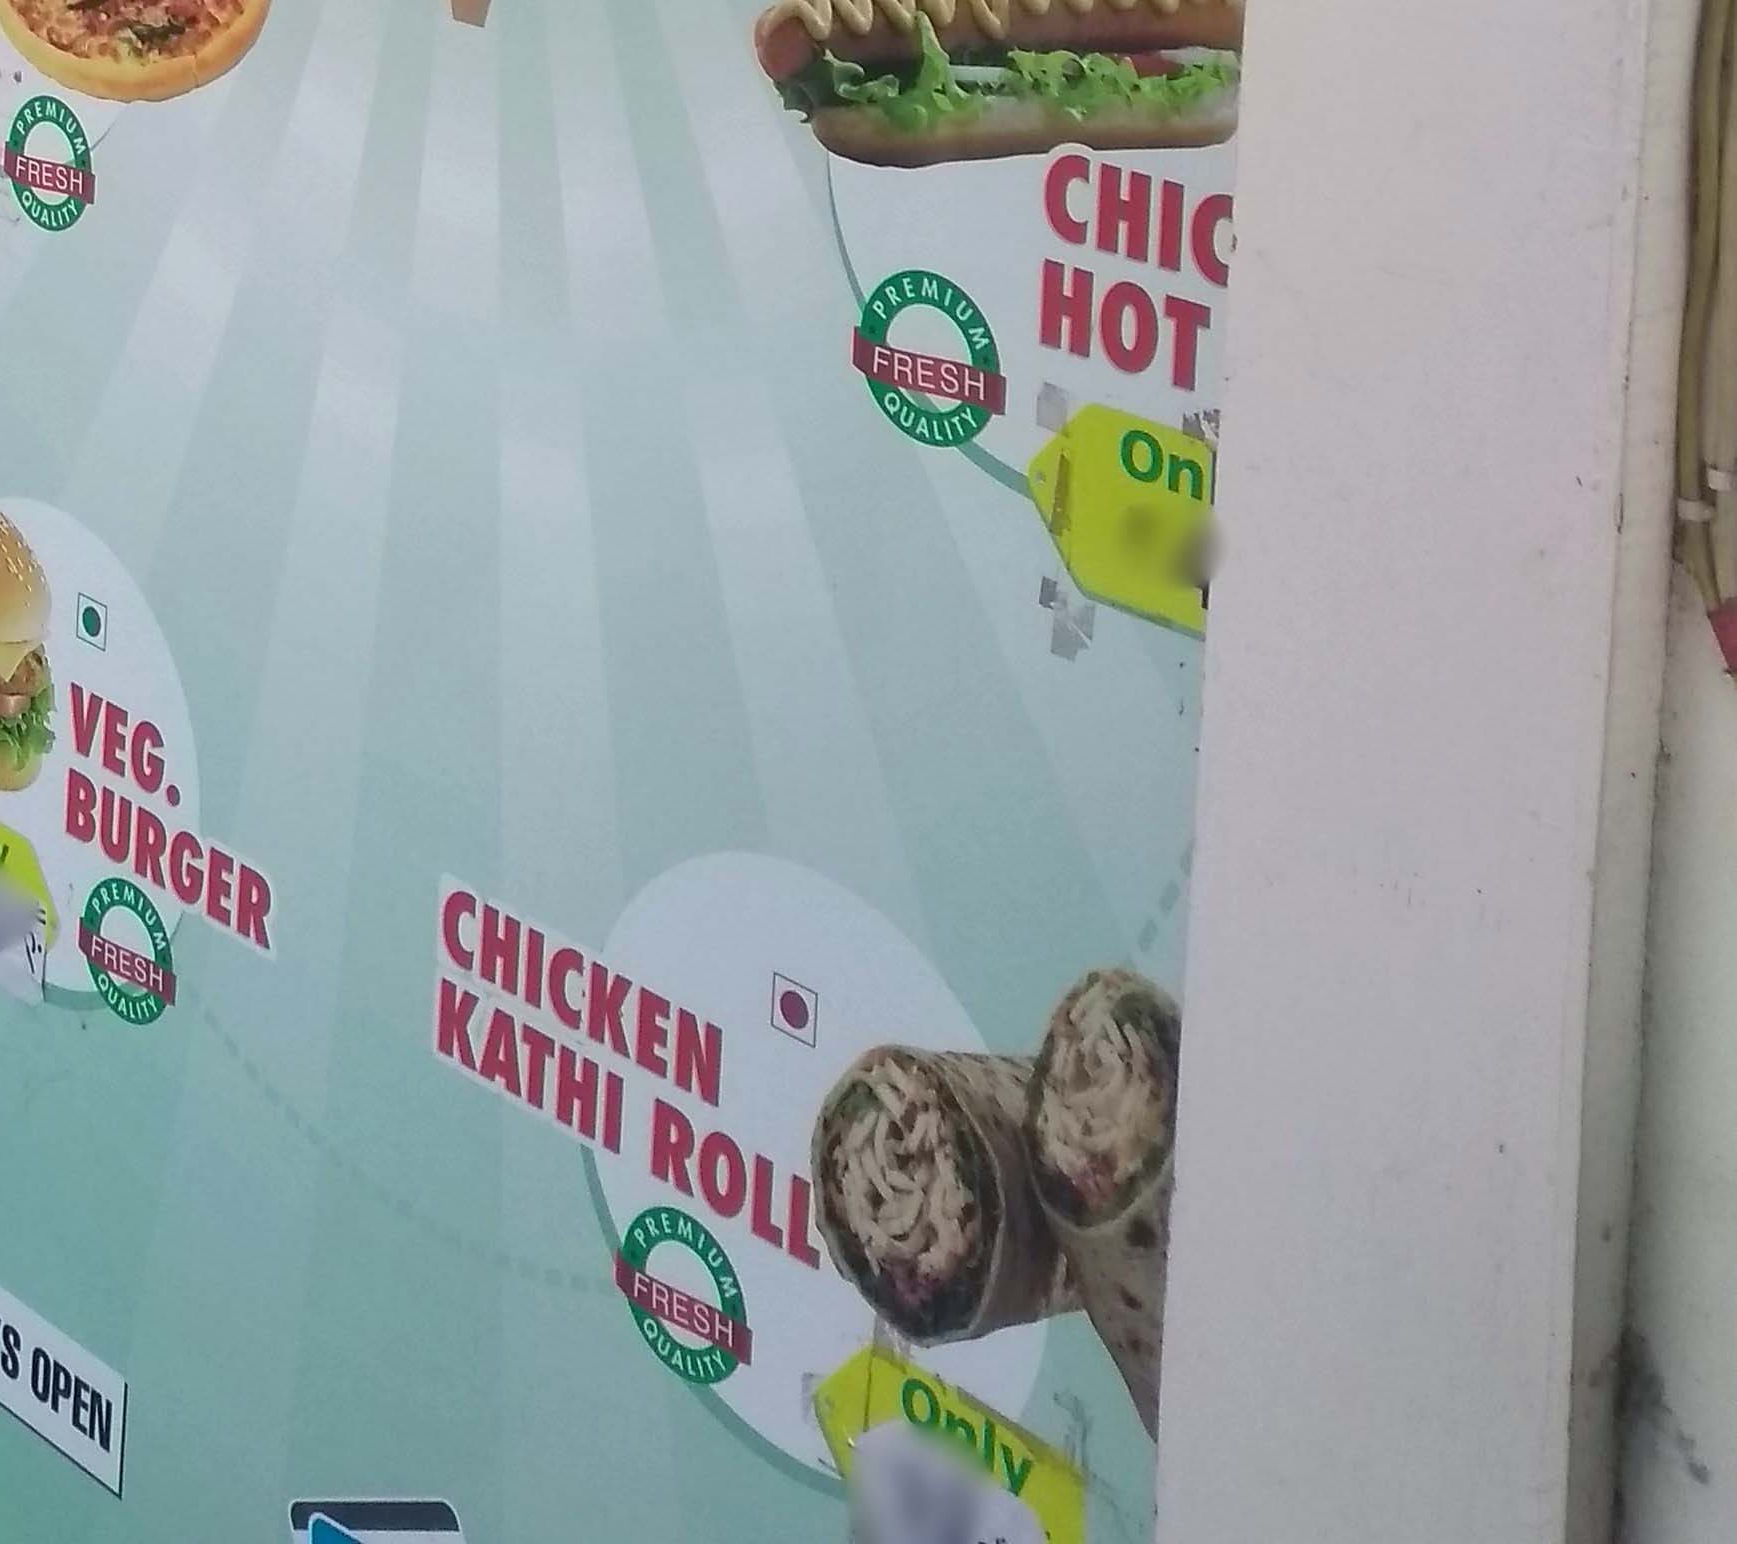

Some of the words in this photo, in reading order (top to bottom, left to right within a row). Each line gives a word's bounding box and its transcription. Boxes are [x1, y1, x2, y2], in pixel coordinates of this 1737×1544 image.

[16, 101, 88, 155] PREMIUM
[15, 155, 83, 195] FRESH
[22, 190, 79, 227] QUALITY
[1043, 153, 1235, 287] CHIC
[872, 277, 991, 351] PREMIUM
[1038, 257, 1212, 393] HOT
[873, 345, 985, 401] FRESH
[884, 391, 978, 441] QUALITY
[69, 680, 181, 808] VEG.
[65, 766, 272, 952] BURGER
[92, 882, 167, 951] PREMIUM
[91, 934, 163, 993] FRESH
[98, 972, 158, 1019] QUALITY
[441, 889, 724, 1108] CHICKEN
[437, 976, 625, 1155] KATHI
[650, 1096, 821, 1270] ROLL
[634, 1213, 738, 1298] PREMIUM
[634, 1272, 734, 1348] FRESH
[643, 1318, 726, 1378] QUALITY
[30, 1345, 113, 1454] OPEN
[901, 1377, 1032, 1497] Only
